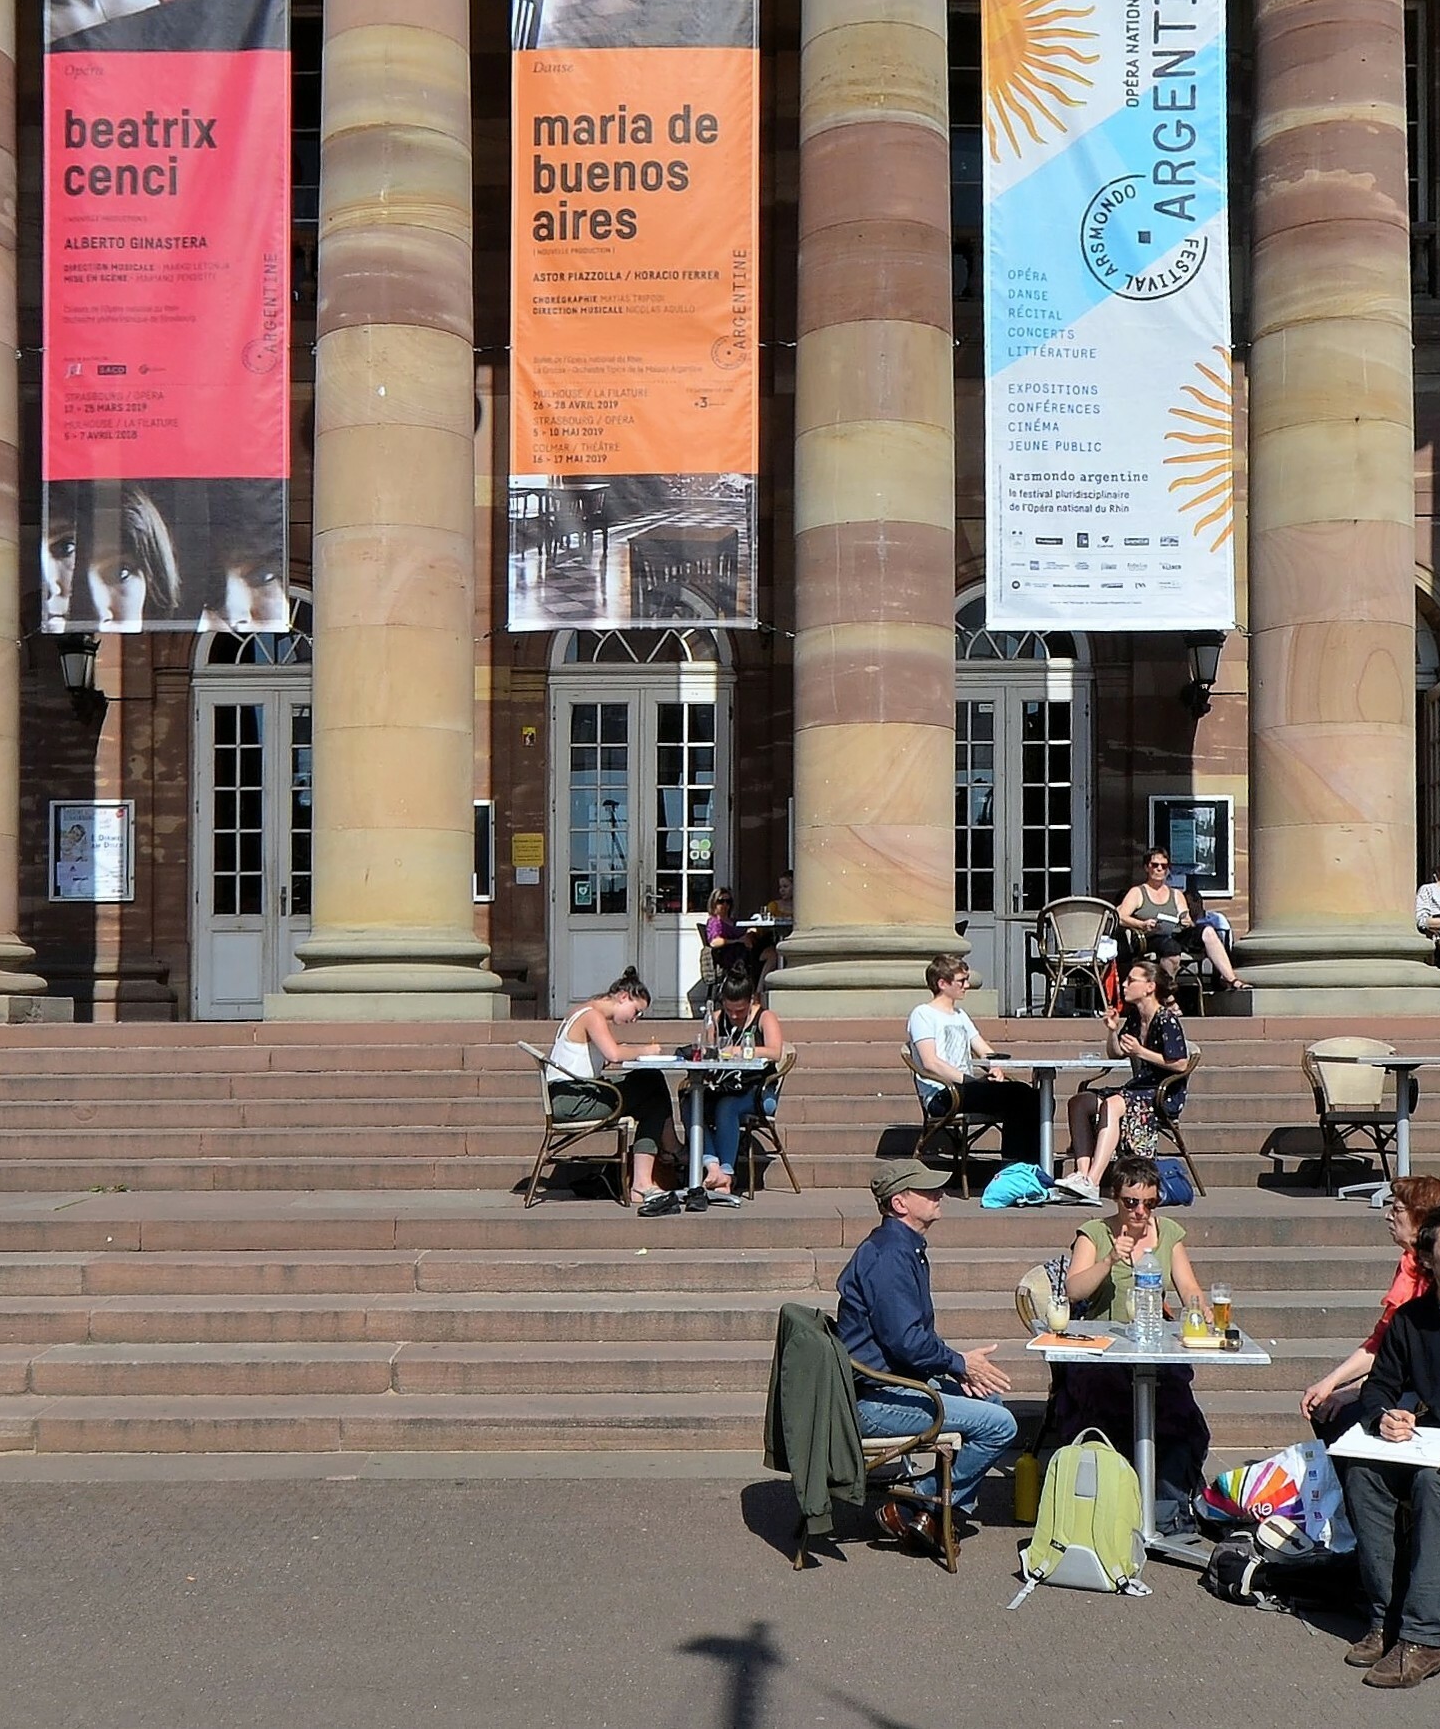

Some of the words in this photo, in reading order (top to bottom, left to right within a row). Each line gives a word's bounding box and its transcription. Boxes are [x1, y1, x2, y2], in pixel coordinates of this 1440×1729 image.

[533, 61, 574, 73] Danse
[1123, 58, 1139, 107] OPÉRA
[65, 109, 218, 149] beatrix
[533, 104, 653, 146] maria
[668, 104, 719, 144] de
[64, 156, 178, 196] cenci
[533, 154, 690, 194] buenos
[533, 200, 638, 242] aires
[1089, 184, 1137, 267] ARSMONDO
[64, 237, 125, 249] ALBERTO
[130, 236, 208, 249] GINASTERA
[1125, 239, 1199, 292] FESTIVAL
[533, 272, 565, 282] ASTOR
[569, 272, 622, 282] PIAZZOLLA
[625, 271, 632, 281] /
[635, 271, 679, 281] HORACIO
[682, 271, 720, 281] FERRER
[1008, 267, 1048, 282] OPÉRA
[732, 250, 747, 349] ARGENTINE
[1008, 289, 1049, 301] DANSE
[264, 253, 278, 353] ARGENTINE
[533, 305, 578, 315] DIRECTION
[581, 305, 623, 315] MUSICALE
[1008, 305, 1063, 321] RÉCITAL
[1008, 327, 1076, 340] CONCERTS
[1008, 345, 1098, 359] LITTÉRATURE
[533, 389, 583, 399] MULHOUSE
[594, 388, 606, 398] LA
[607, 388, 648, 398] FILATURE
[1008, 383, 1099, 395] EXPOSITIONS
[97, 403, 123, 412] MARS
[533, 401, 544, 410] 26
[554, 401, 567, 409] 28
[569, 400, 595, 409] AVRIL
[597, 400, 619, 409] 2019
[1008, 399, 1101, 414] CONFÉRENCES
[533, 416, 594, 426] STRASBOURG
[1008, 418, 1060, 433] CINÉMA
[86, 431, 113, 440] AVRIL
[533, 428, 539, 437] 5
[549, 428, 560, 436] 10
[562, 428, 580, 436] MAI
[582, 427, 604, 436] 2019
[533, 443, 569, 453] COLMAR
[1008, 440, 1050, 451] JEUNE
[1055, 440, 1102, 452] PUBLIC
[554, 455, 564, 464] 17
[566, 455, 584, 463] MAI
[586, 455, 608, 463] 2019
[1008, 471, 1076, 482] arsmondo
[1080, 471, 1149, 484] argentine
[1008, 489, 1017, 498] le
[1019, 489, 1053, 499] festival
[1055, 490, 1130, 500] pluridisciplinaire
[1008, 503, 1020, 512] de
[1057, 504, 1093, 513] national
[1095, 504, 1106, 513] du
[1109, 504, 1130, 513] Rhin
